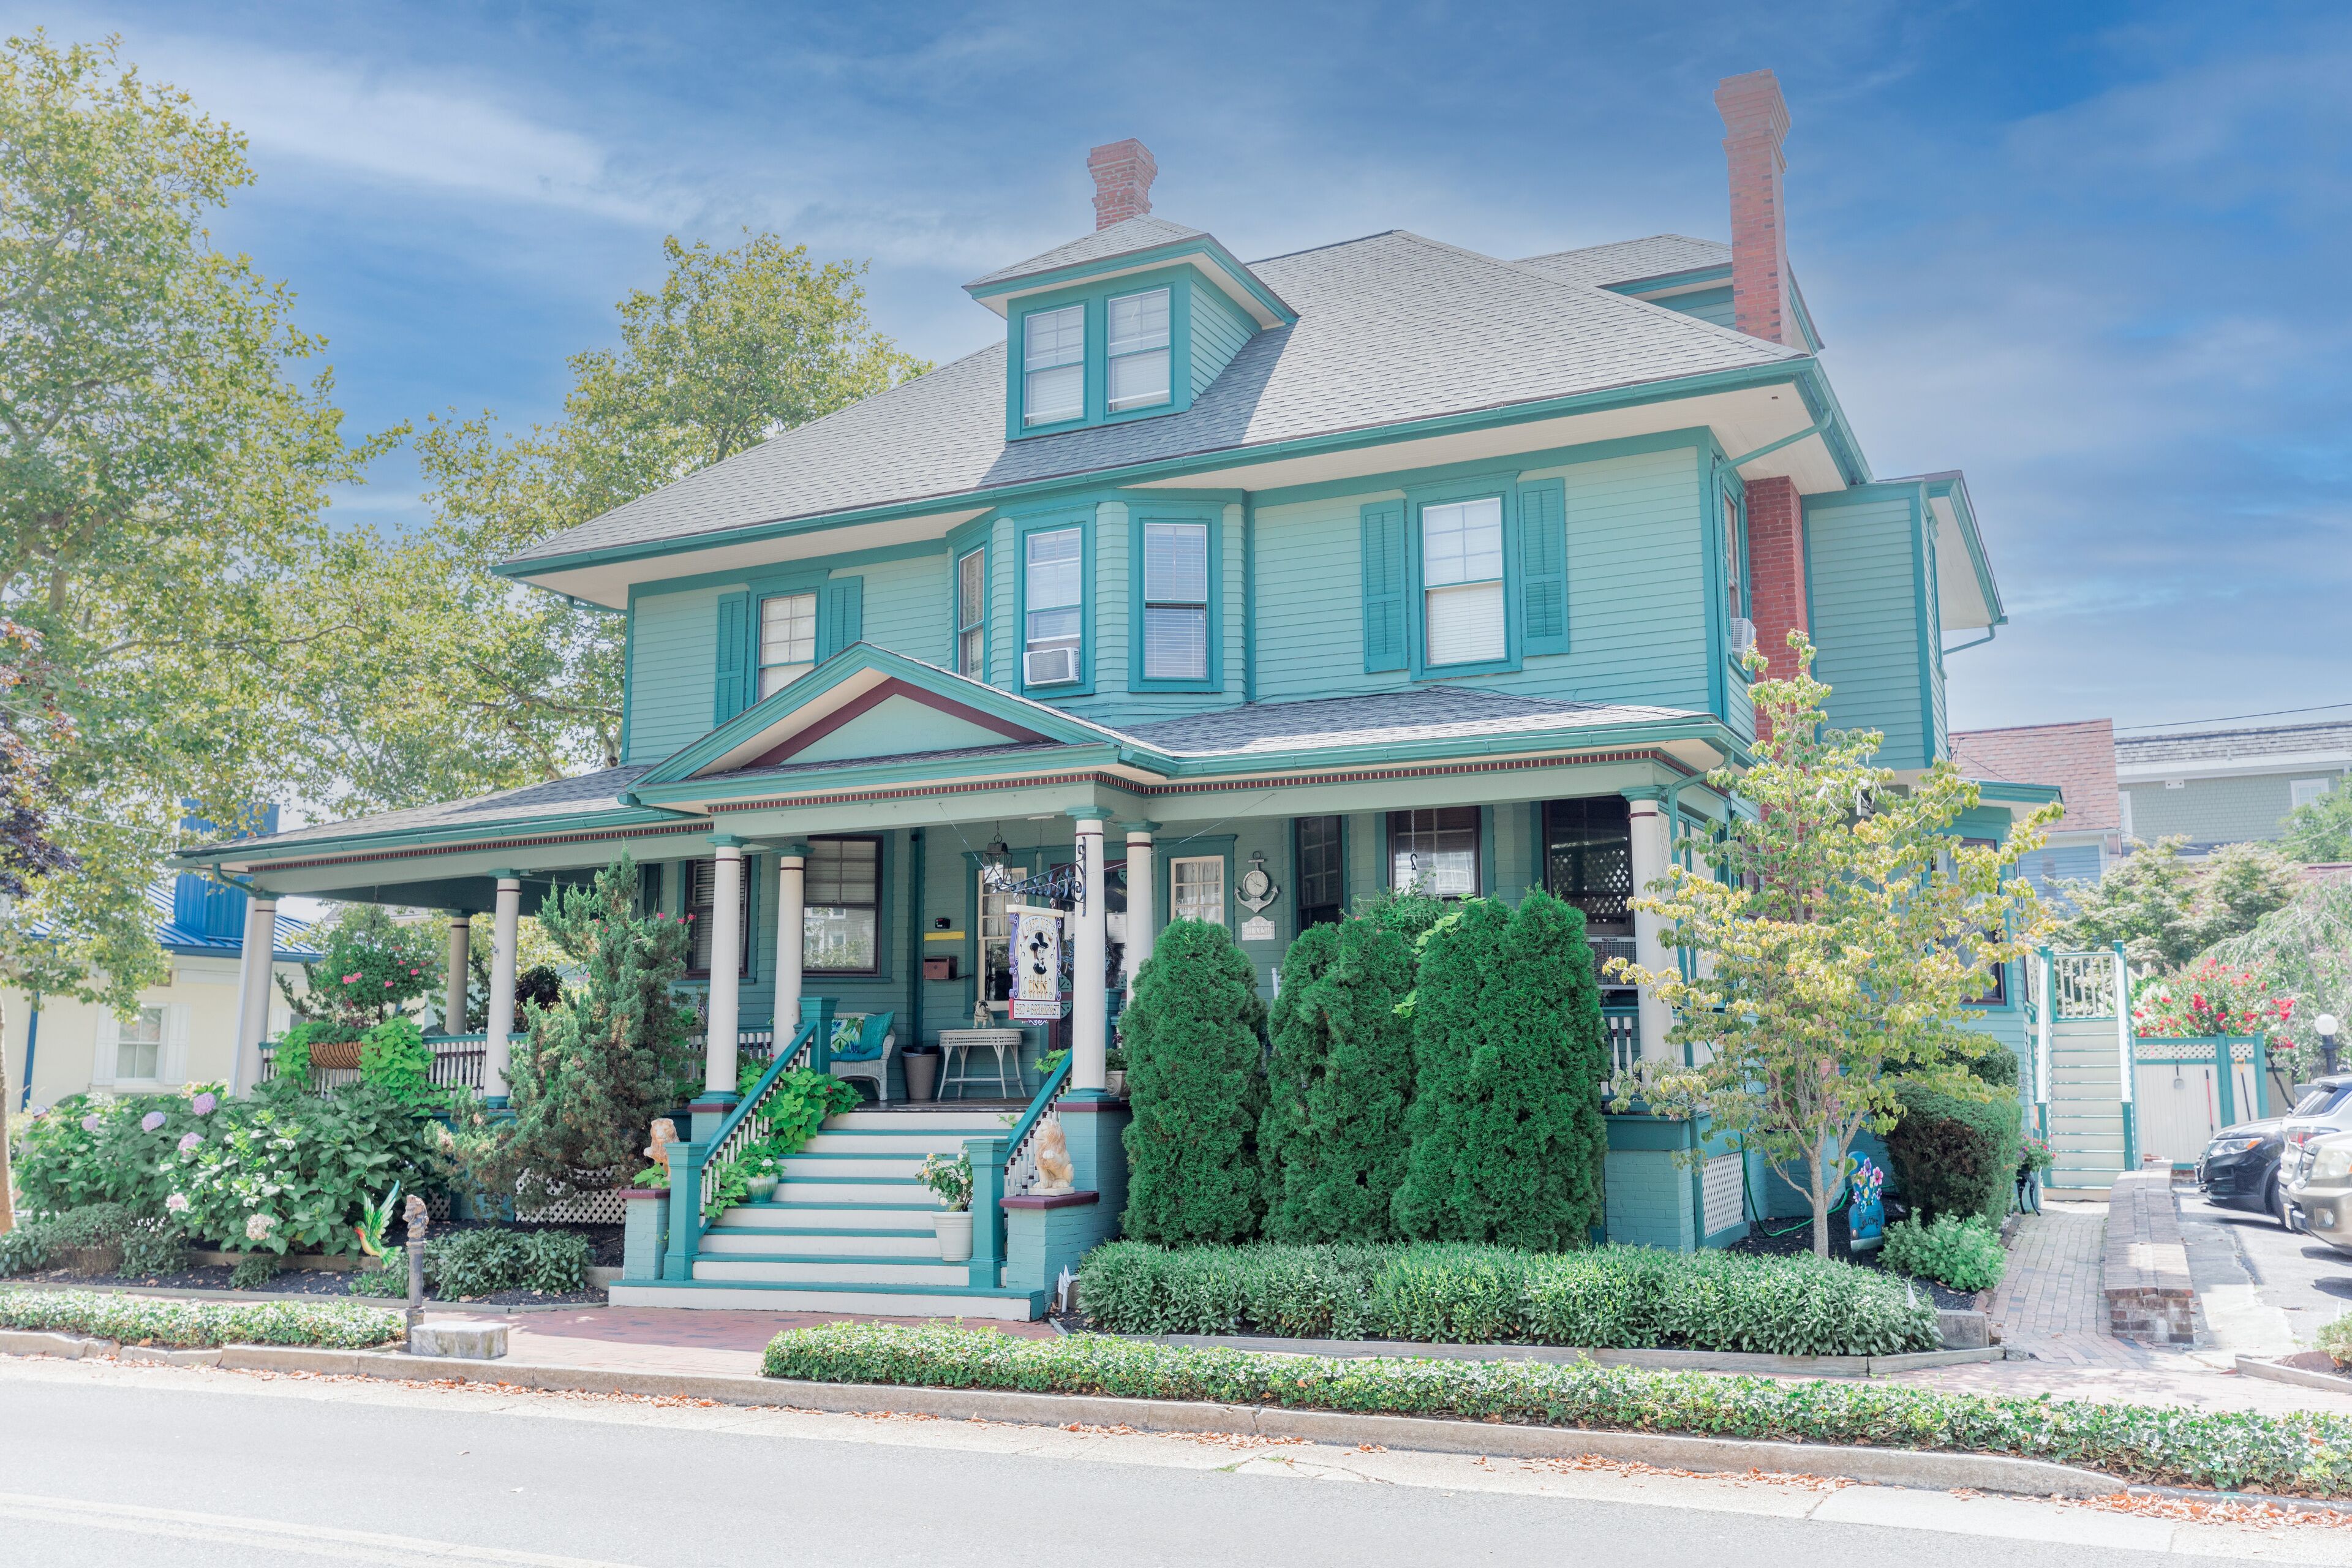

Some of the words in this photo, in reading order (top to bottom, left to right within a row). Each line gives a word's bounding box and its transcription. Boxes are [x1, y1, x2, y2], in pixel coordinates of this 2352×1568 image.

[1028, 977, 1048, 998] INN
[1015, 1003, 1025, 1015] BED
[1030, 1004, 1060, 1016] BREAKFAST
